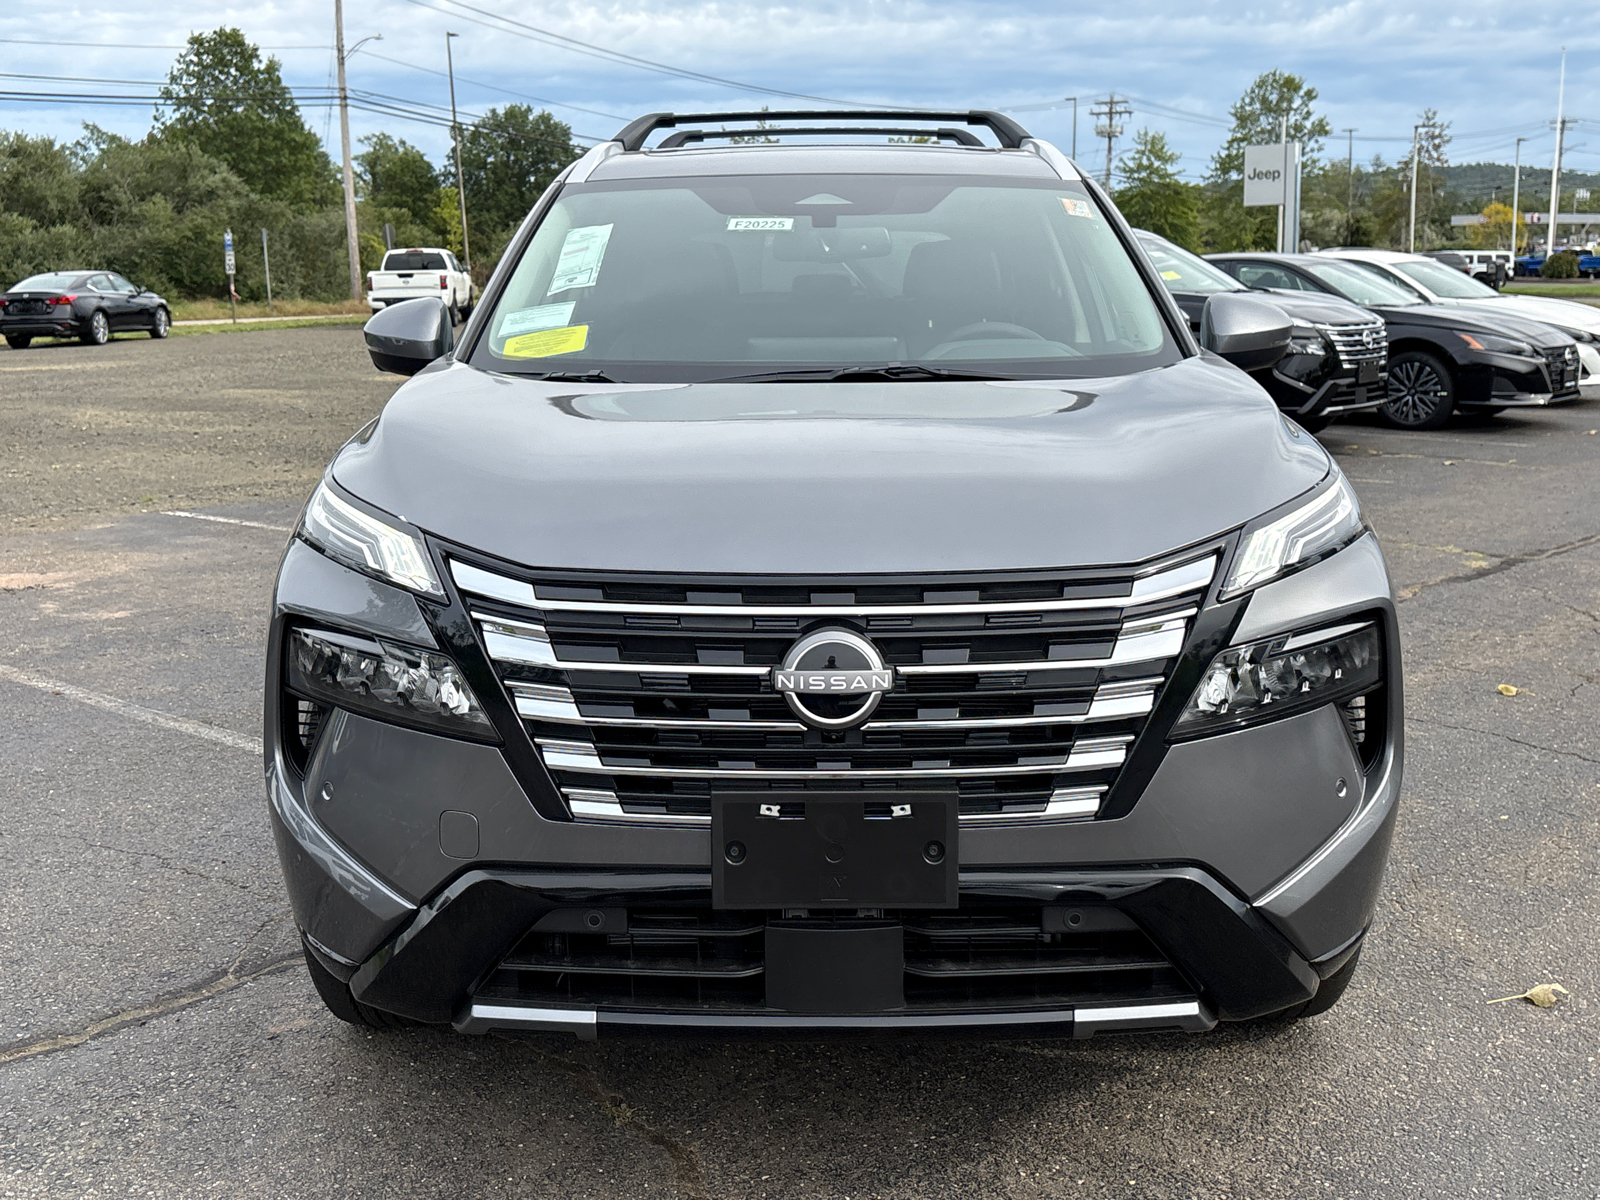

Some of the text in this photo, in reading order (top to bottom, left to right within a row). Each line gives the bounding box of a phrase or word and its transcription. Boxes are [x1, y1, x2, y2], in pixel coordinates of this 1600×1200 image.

[1247, 166, 1281, 182] Jeep
[734, 220, 786, 229] F20225
[777, 673, 889, 690] NISSAN
